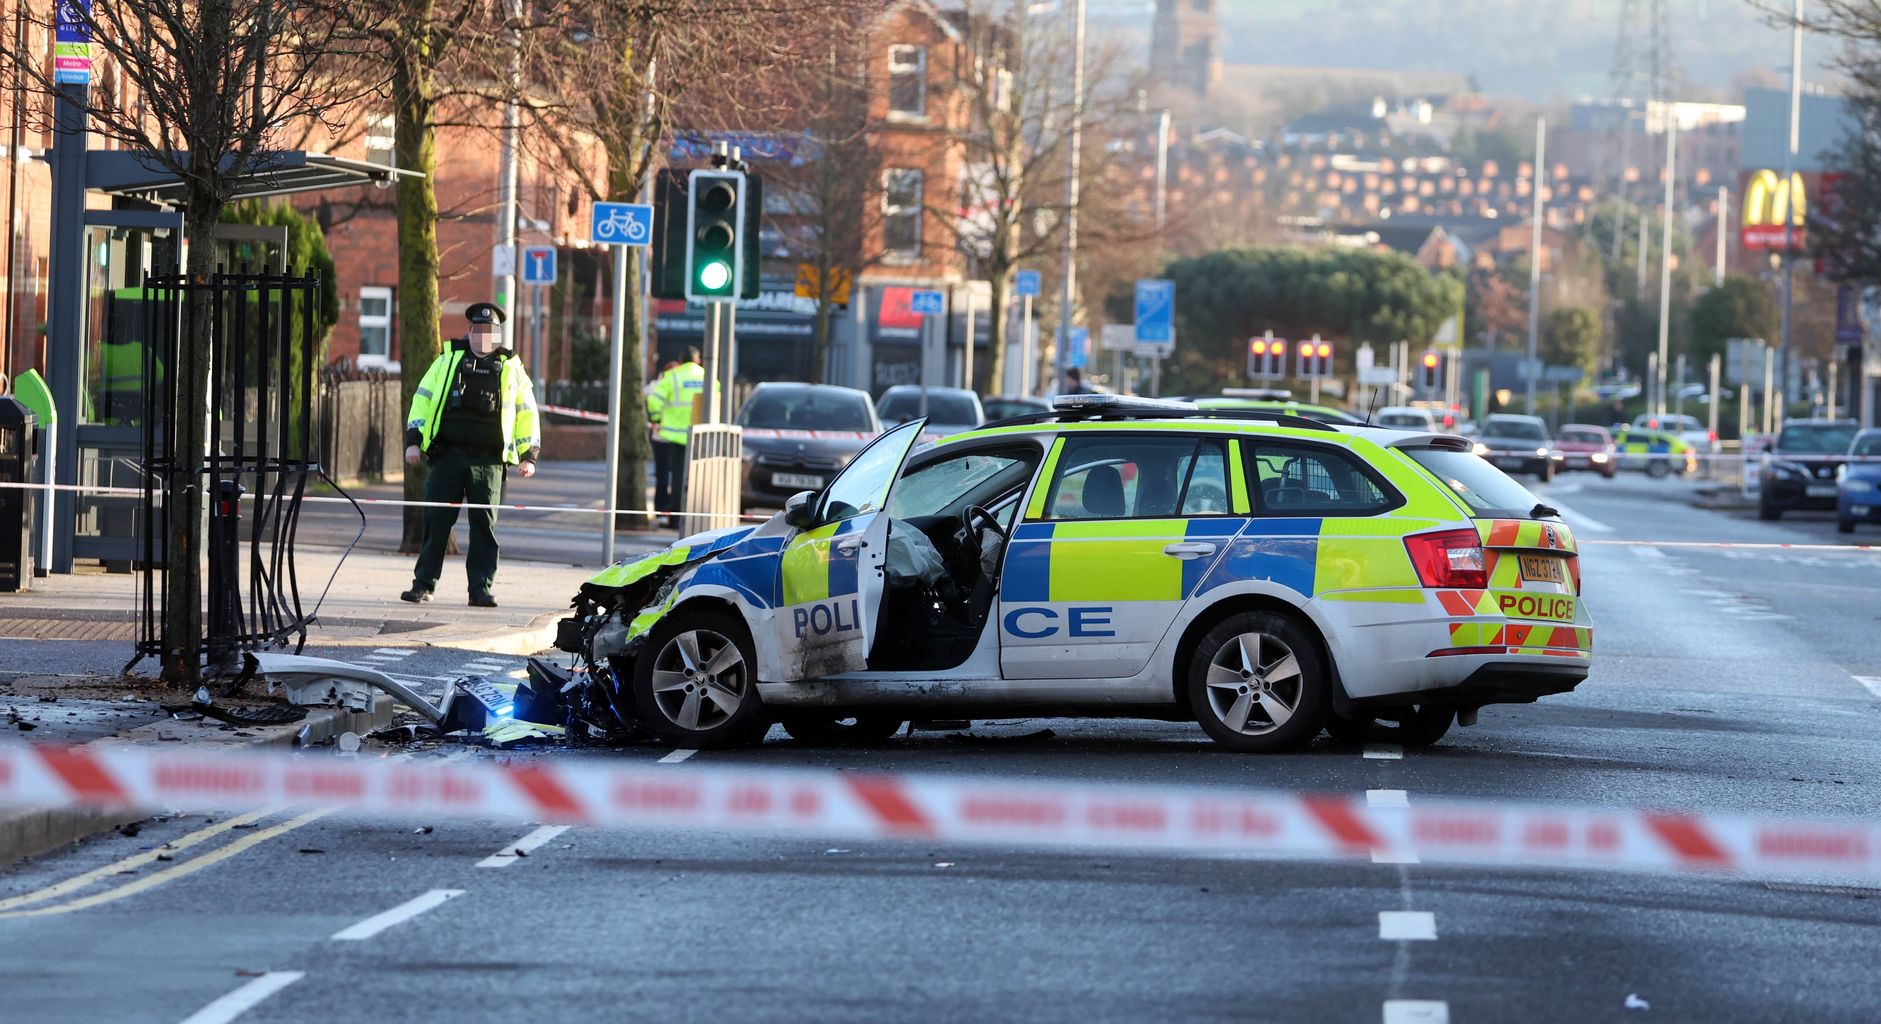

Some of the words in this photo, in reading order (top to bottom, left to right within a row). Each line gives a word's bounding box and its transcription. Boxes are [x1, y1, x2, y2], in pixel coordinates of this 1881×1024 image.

[60, 24, 86, 32] GLIDR
[1523, 557, 1541, 577] NGZ
[1501, 595, 1574, 619] POLICE
